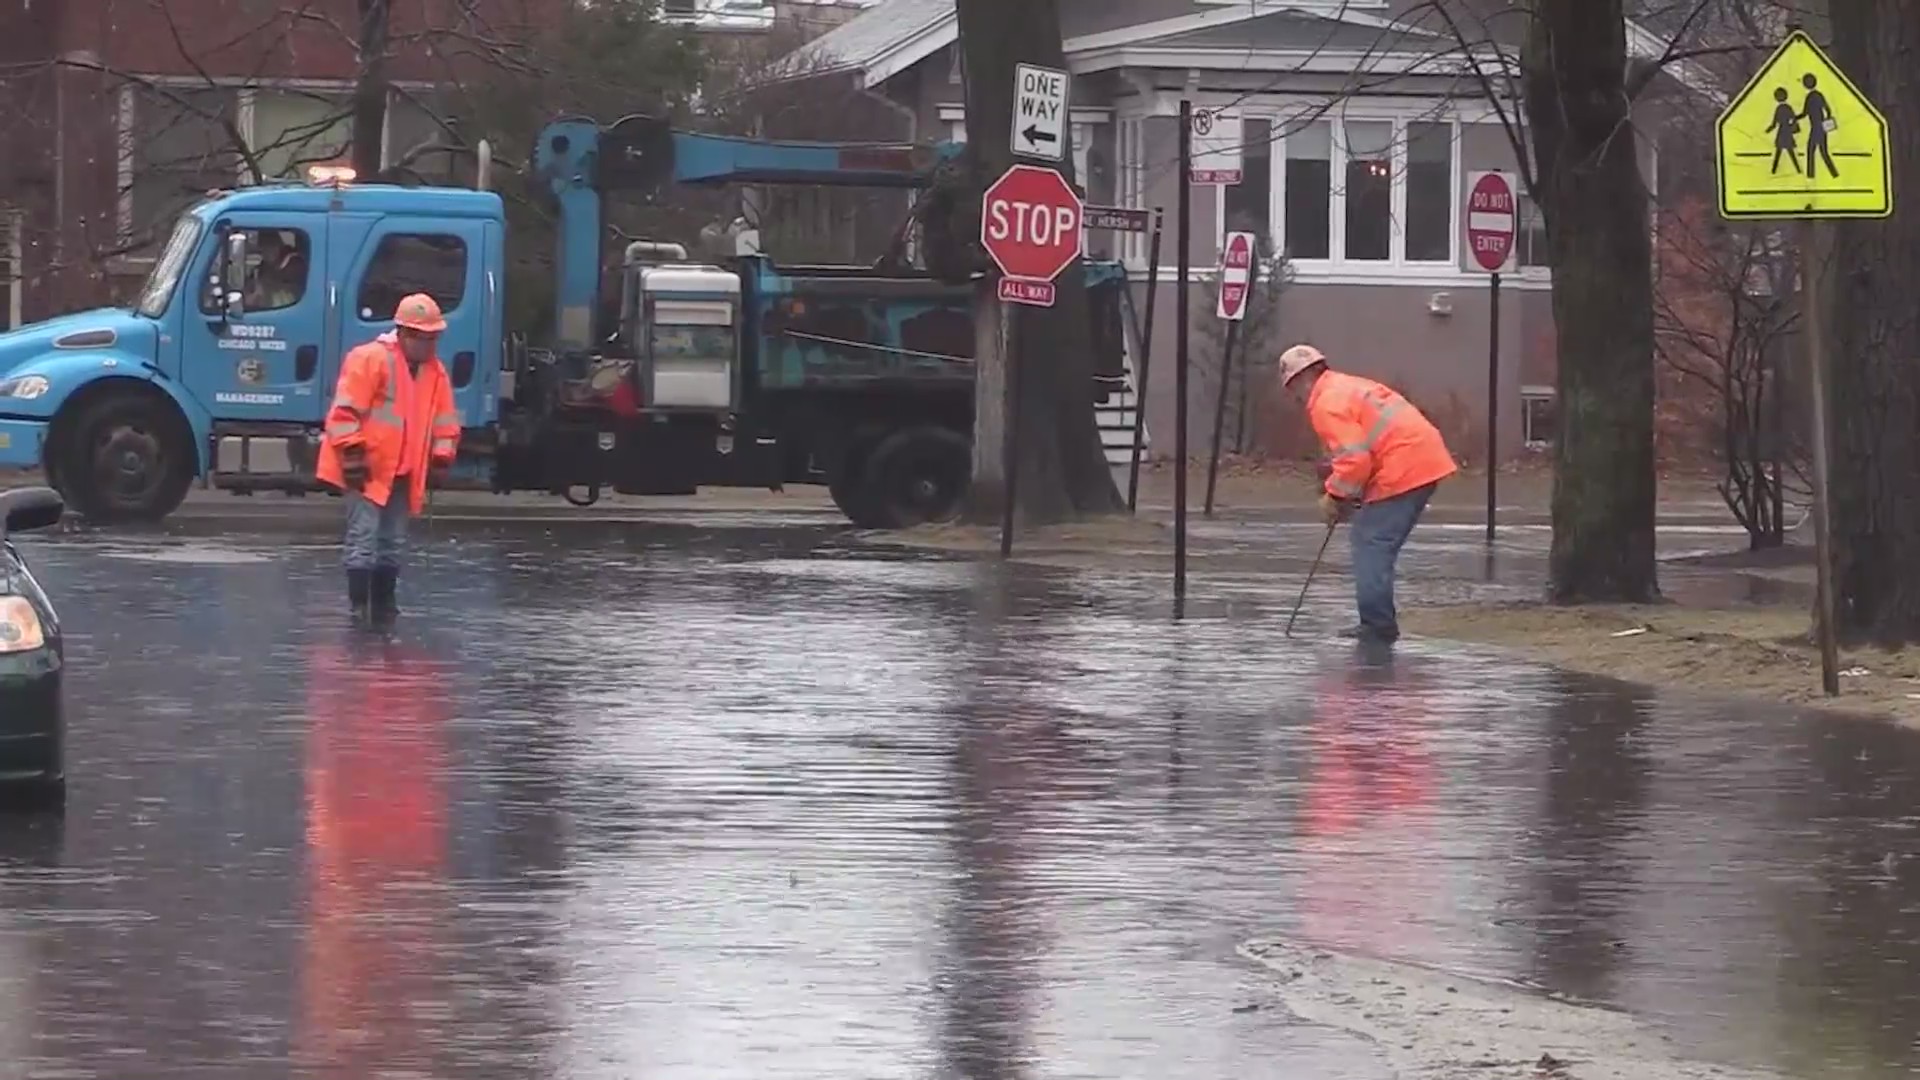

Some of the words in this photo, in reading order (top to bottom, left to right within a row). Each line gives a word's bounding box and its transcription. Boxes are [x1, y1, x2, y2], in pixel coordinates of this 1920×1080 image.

[1024, 73, 1061, 98] ONE
[1021, 97, 1060, 121] WAY
[1474, 193, 1487, 208] DO
[1490, 193, 1509, 208] NOT
[989, 200, 1074, 247] STOP
[1477, 235, 1505, 251] ENTER
[1003, 283, 1025, 298] ALL
[1028, 285, 1049, 300] WAY
[216, 392, 284, 404] MANAGEMENT
